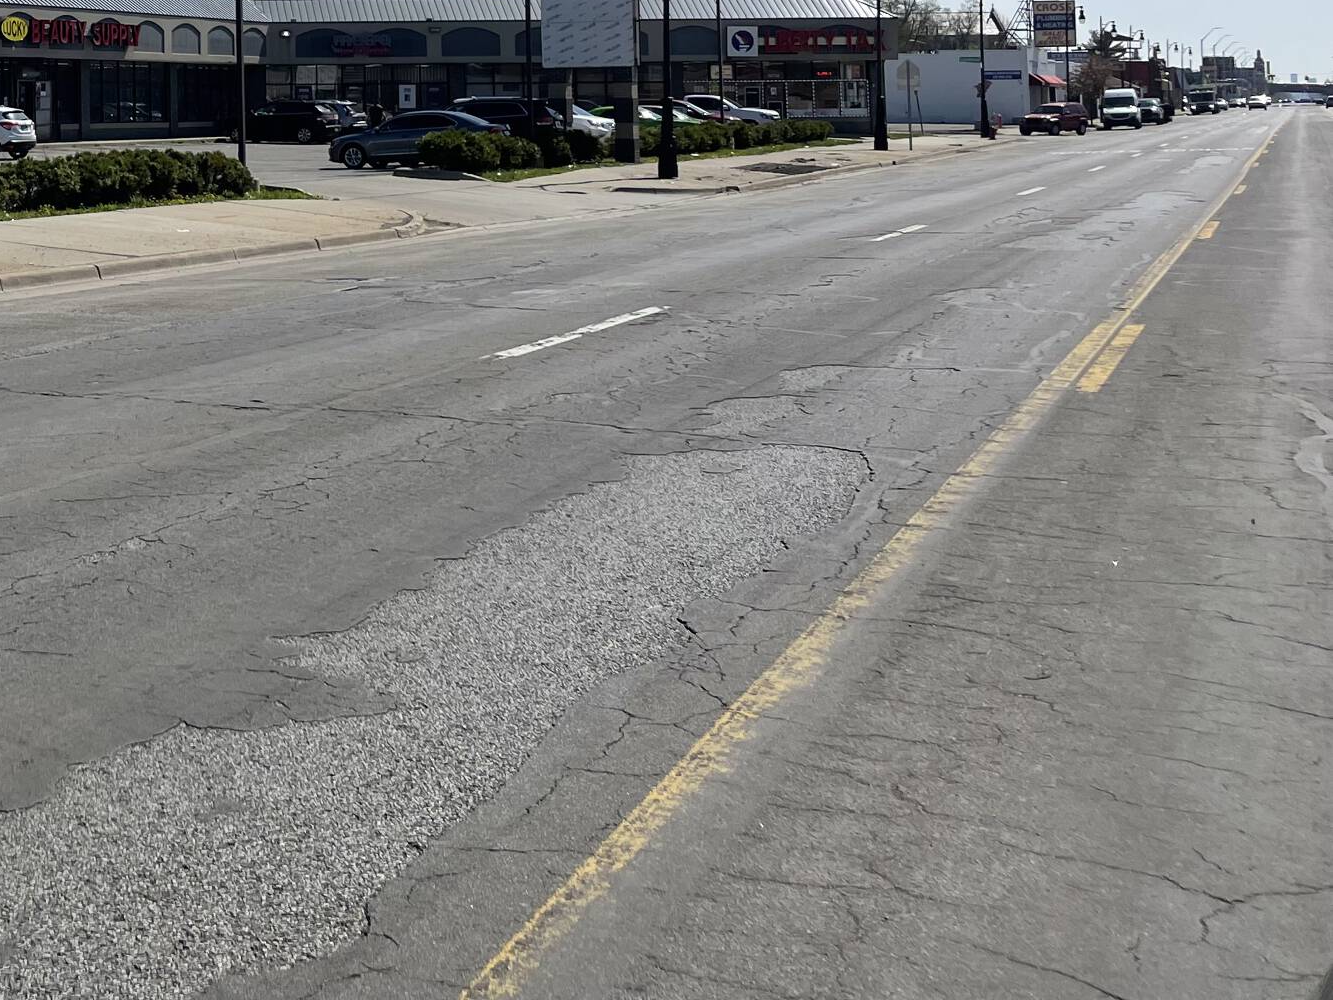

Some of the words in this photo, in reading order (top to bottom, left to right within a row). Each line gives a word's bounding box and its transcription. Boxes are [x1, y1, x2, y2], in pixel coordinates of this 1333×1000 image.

[1, 18, 27, 37] LUCKY
[31, 19, 87, 44] BEAUTY
[92, 23, 141, 46] SUPPLY
